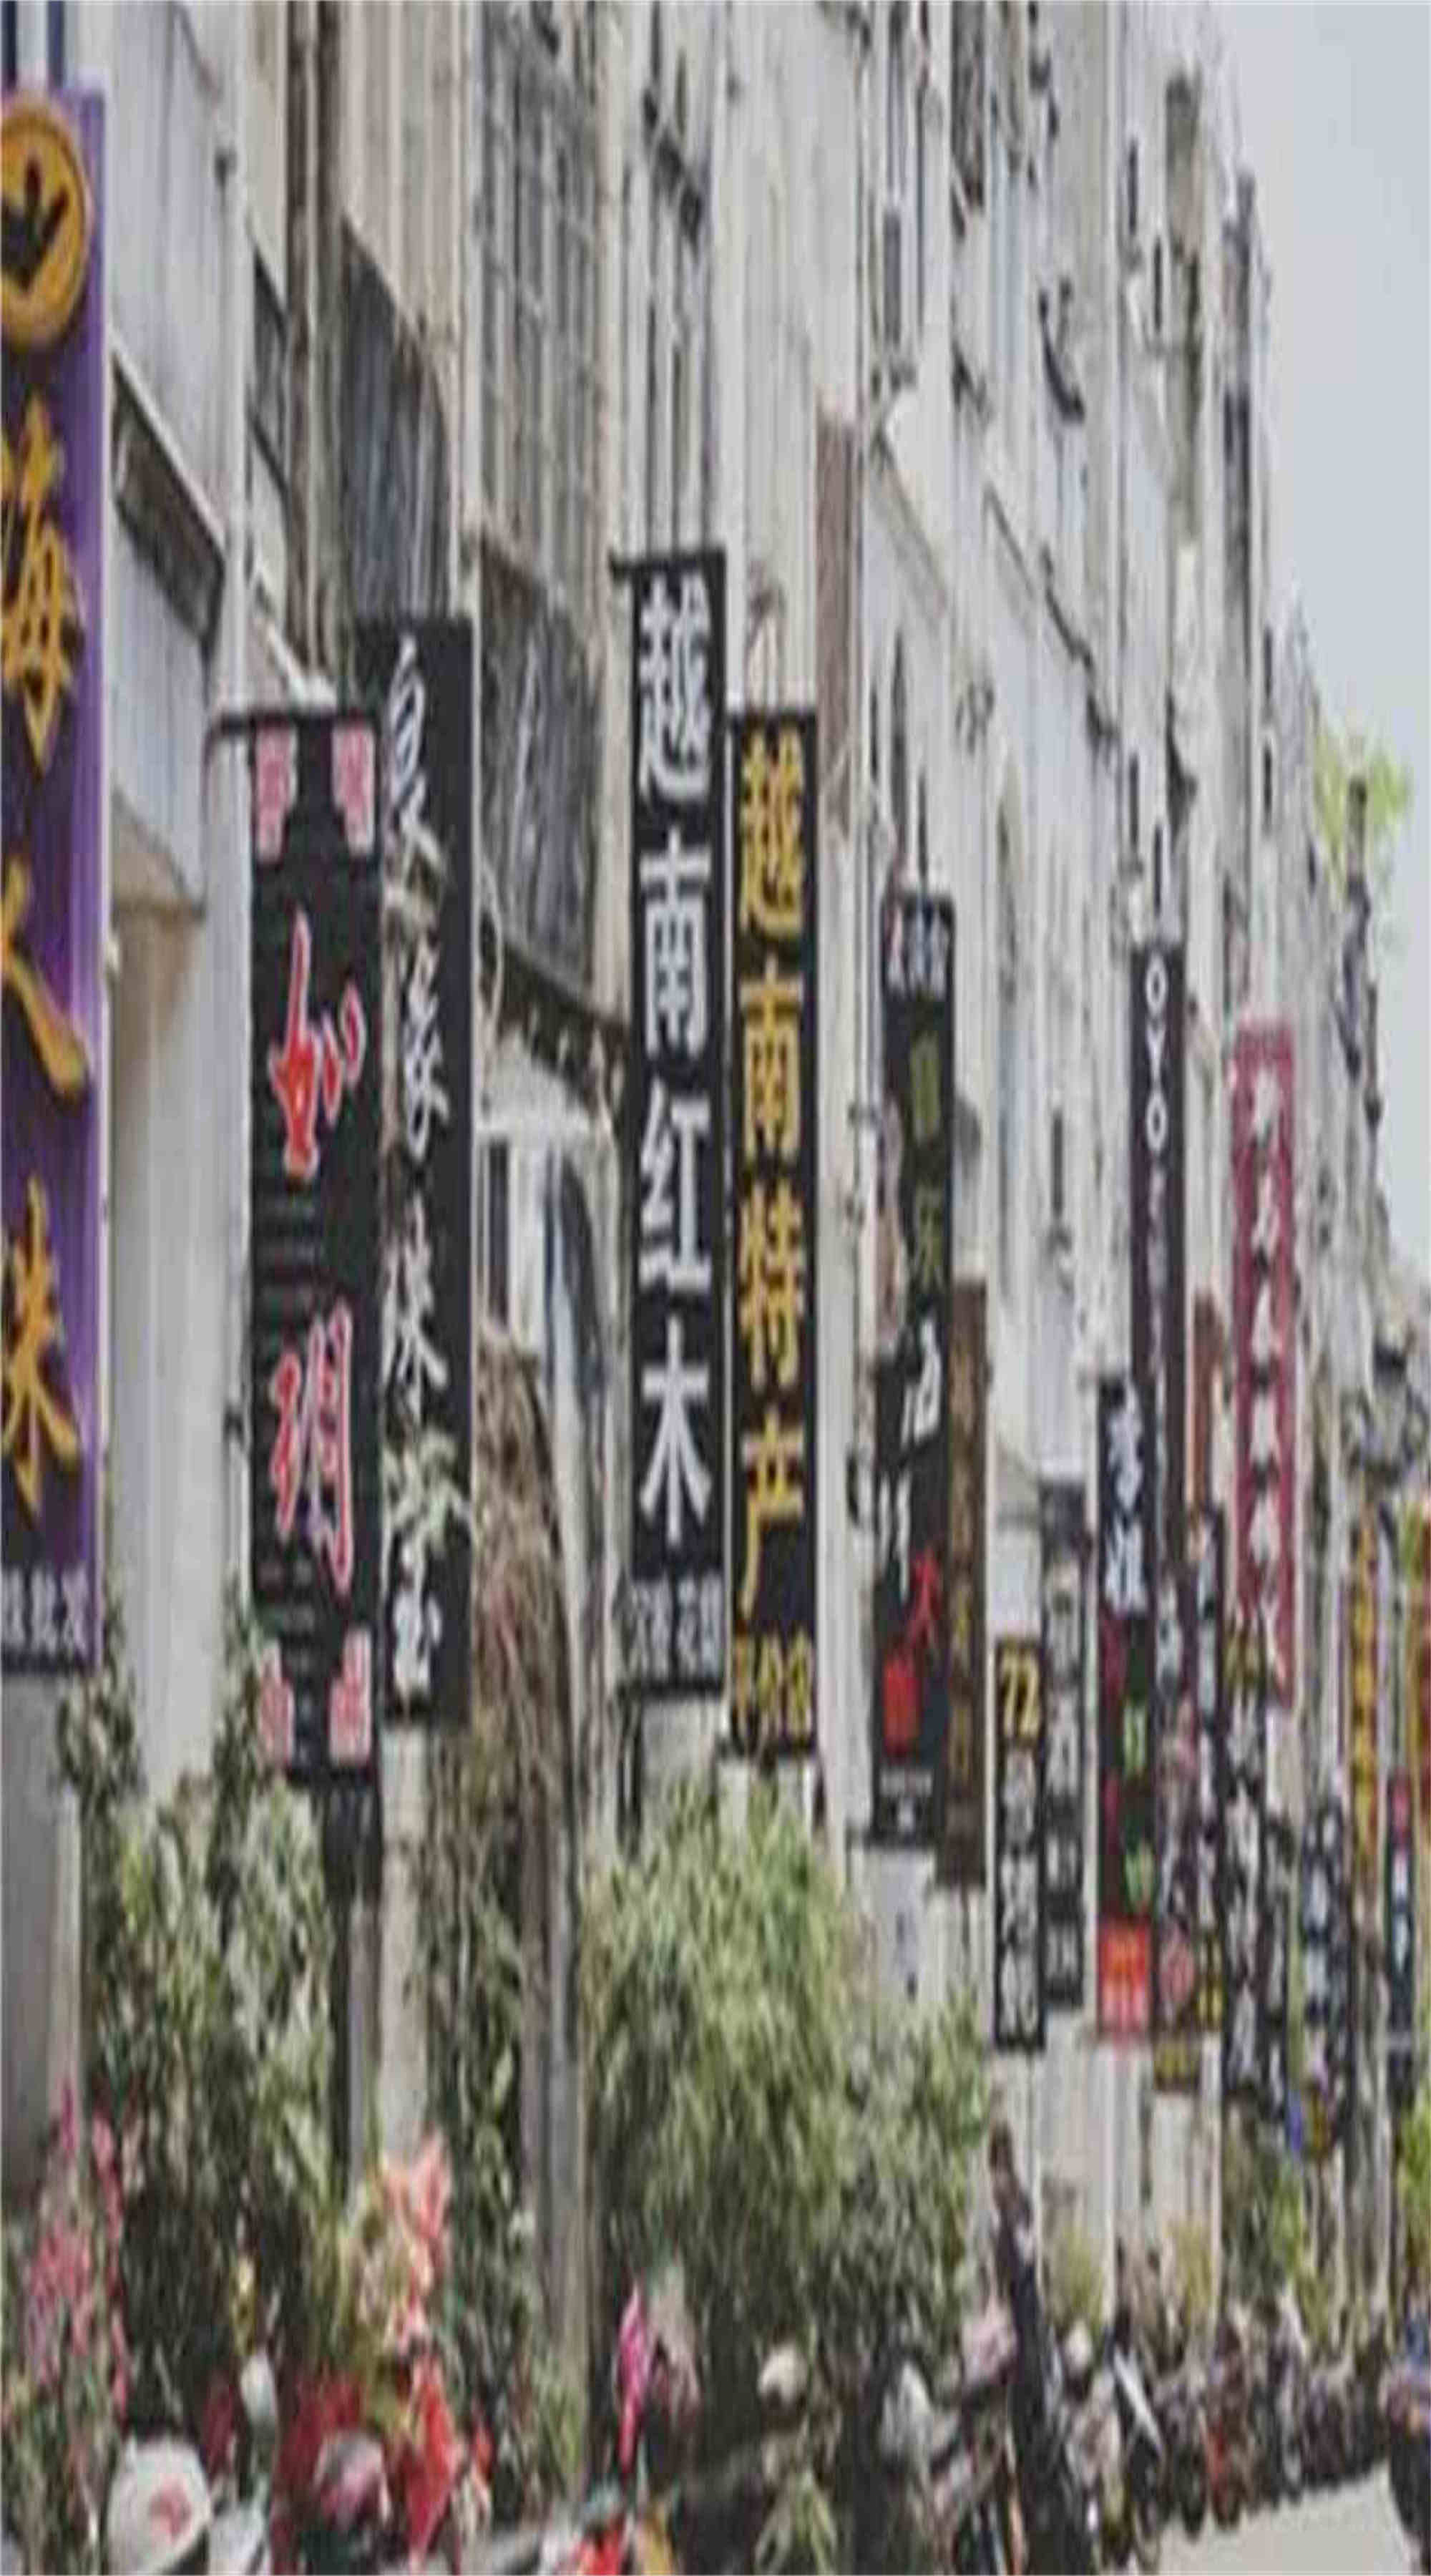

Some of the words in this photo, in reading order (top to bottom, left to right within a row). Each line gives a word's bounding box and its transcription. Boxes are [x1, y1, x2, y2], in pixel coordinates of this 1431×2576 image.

[639, 576, 711, 1546] 越南红木
[739, 726, 805, 1619] 越南特产
[1144, 950, 1169, 1156] OYO
